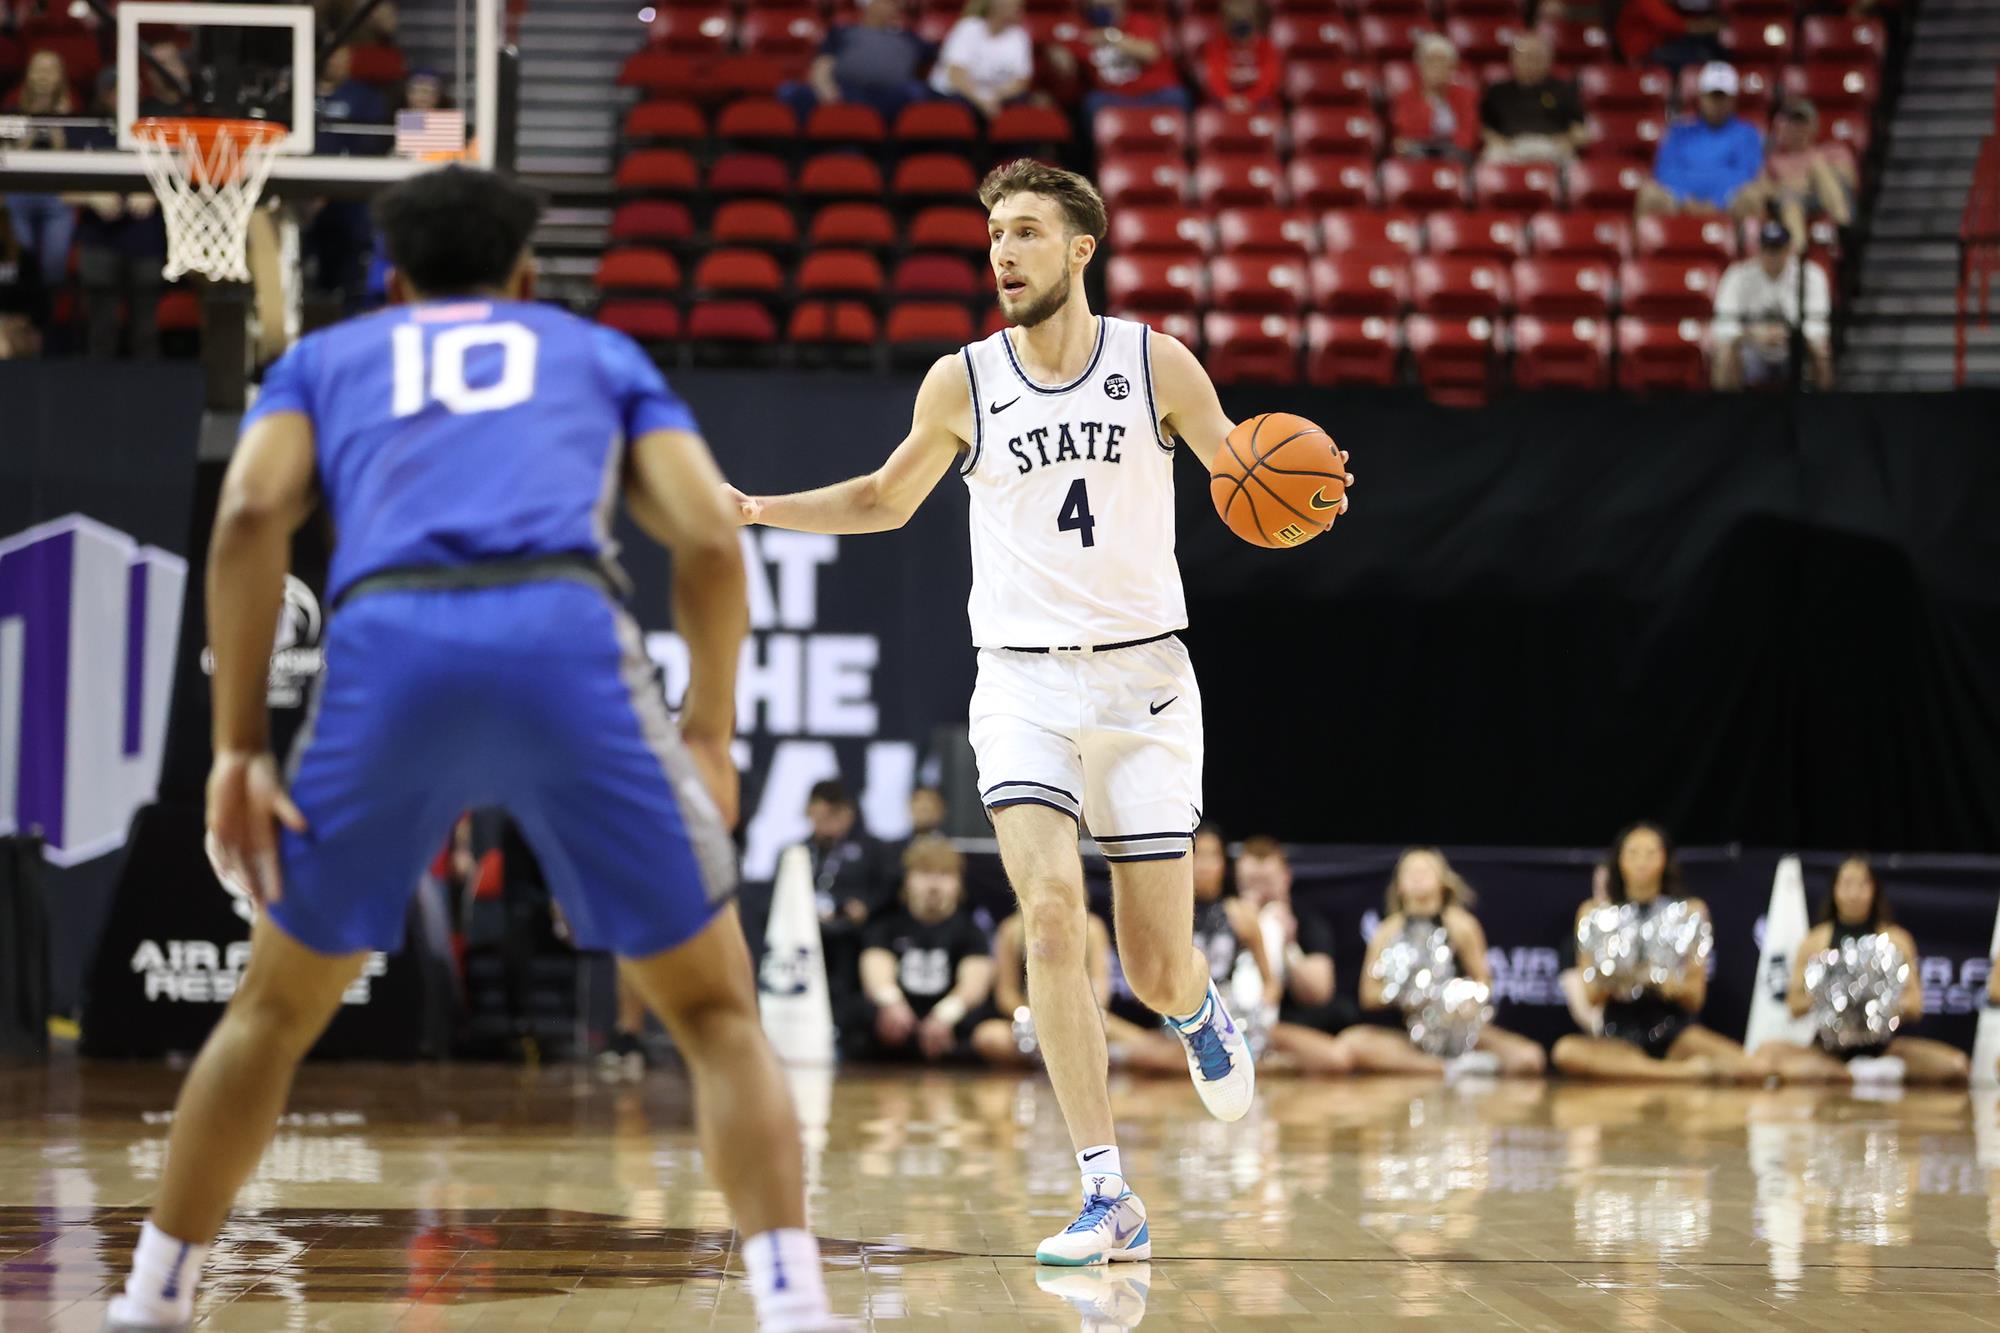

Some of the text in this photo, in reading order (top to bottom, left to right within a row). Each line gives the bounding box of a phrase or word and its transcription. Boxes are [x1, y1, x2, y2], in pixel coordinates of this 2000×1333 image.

[392, 321, 538, 418] 10
[1107, 383, 1129, 397] 33
[1008, 421, 1126, 475] STATE
[1057, 478, 1095, 548] 4
